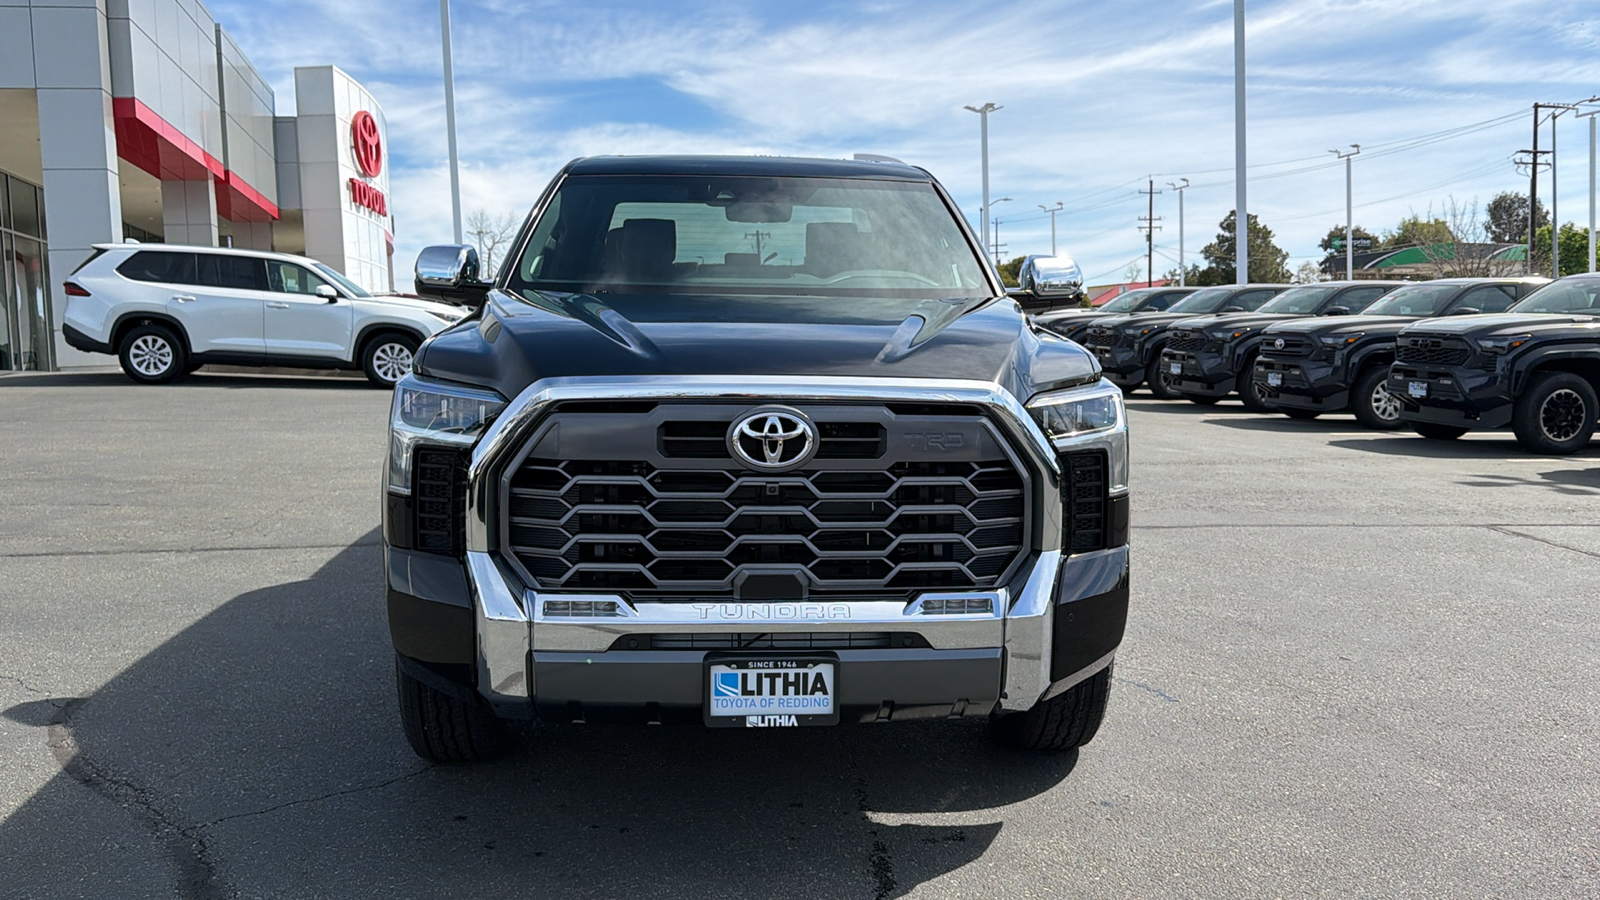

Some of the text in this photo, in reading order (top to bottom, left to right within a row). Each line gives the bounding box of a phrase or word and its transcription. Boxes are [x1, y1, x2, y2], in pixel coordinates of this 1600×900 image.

[349, 178, 387, 217] TOYOTA
[903, 432, 964, 451] TRD
[692, 604, 852, 620] TUNDRA
[741, 672, 829, 697] LITHIA
[714, 698, 829, 708] TOYOTA OF REDDING
[757, 715, 798, 727] LITHIA
